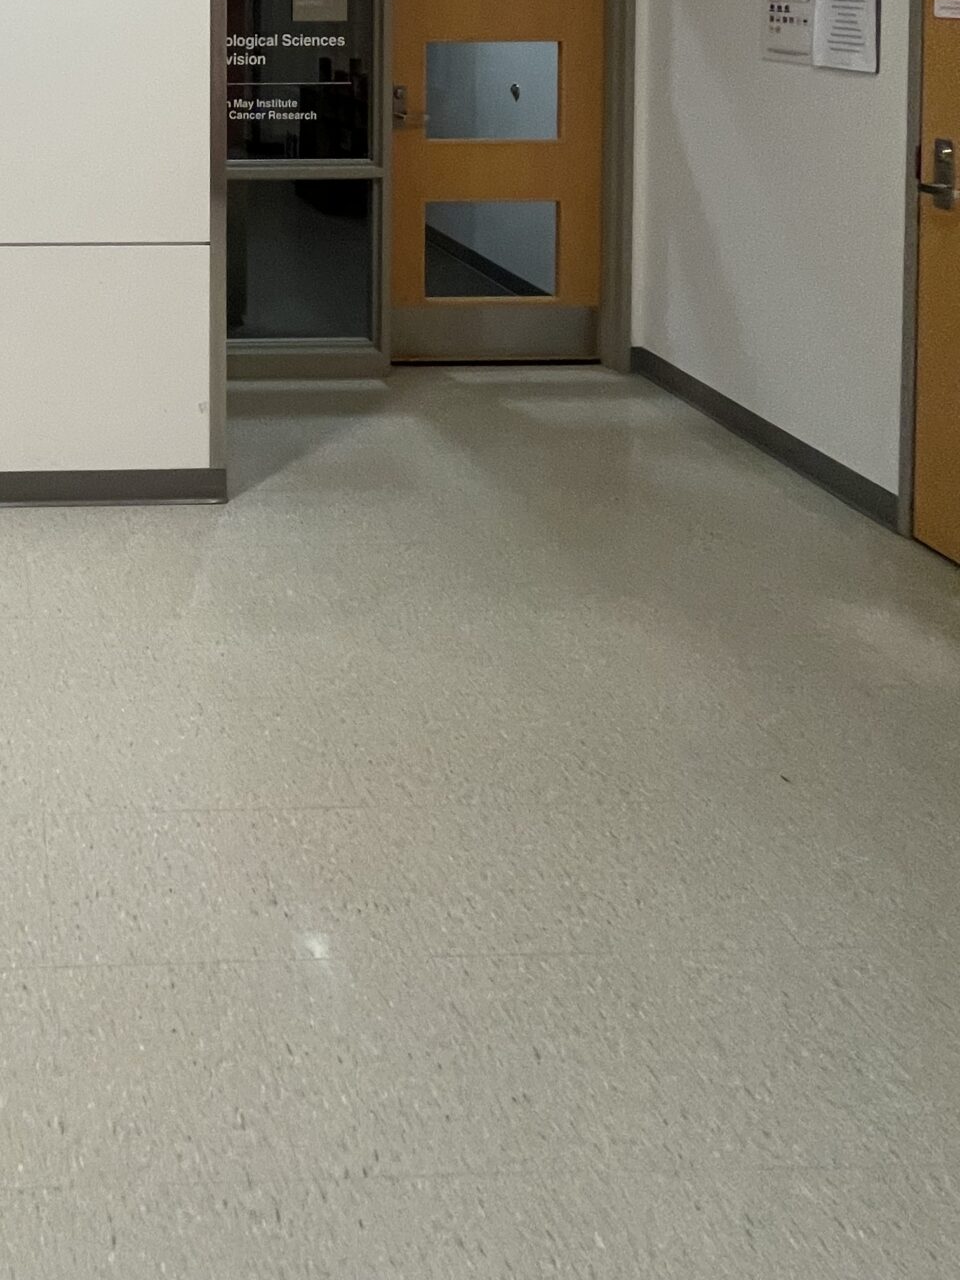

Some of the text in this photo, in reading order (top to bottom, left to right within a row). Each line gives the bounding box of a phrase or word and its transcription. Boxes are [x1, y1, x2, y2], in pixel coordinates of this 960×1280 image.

[282, 33, 346, 47] Sciences
[233, 98, 254, 110] May
[256, 98, 298, 108] Institute
[229, 110, 317, 120] Cancer Research
